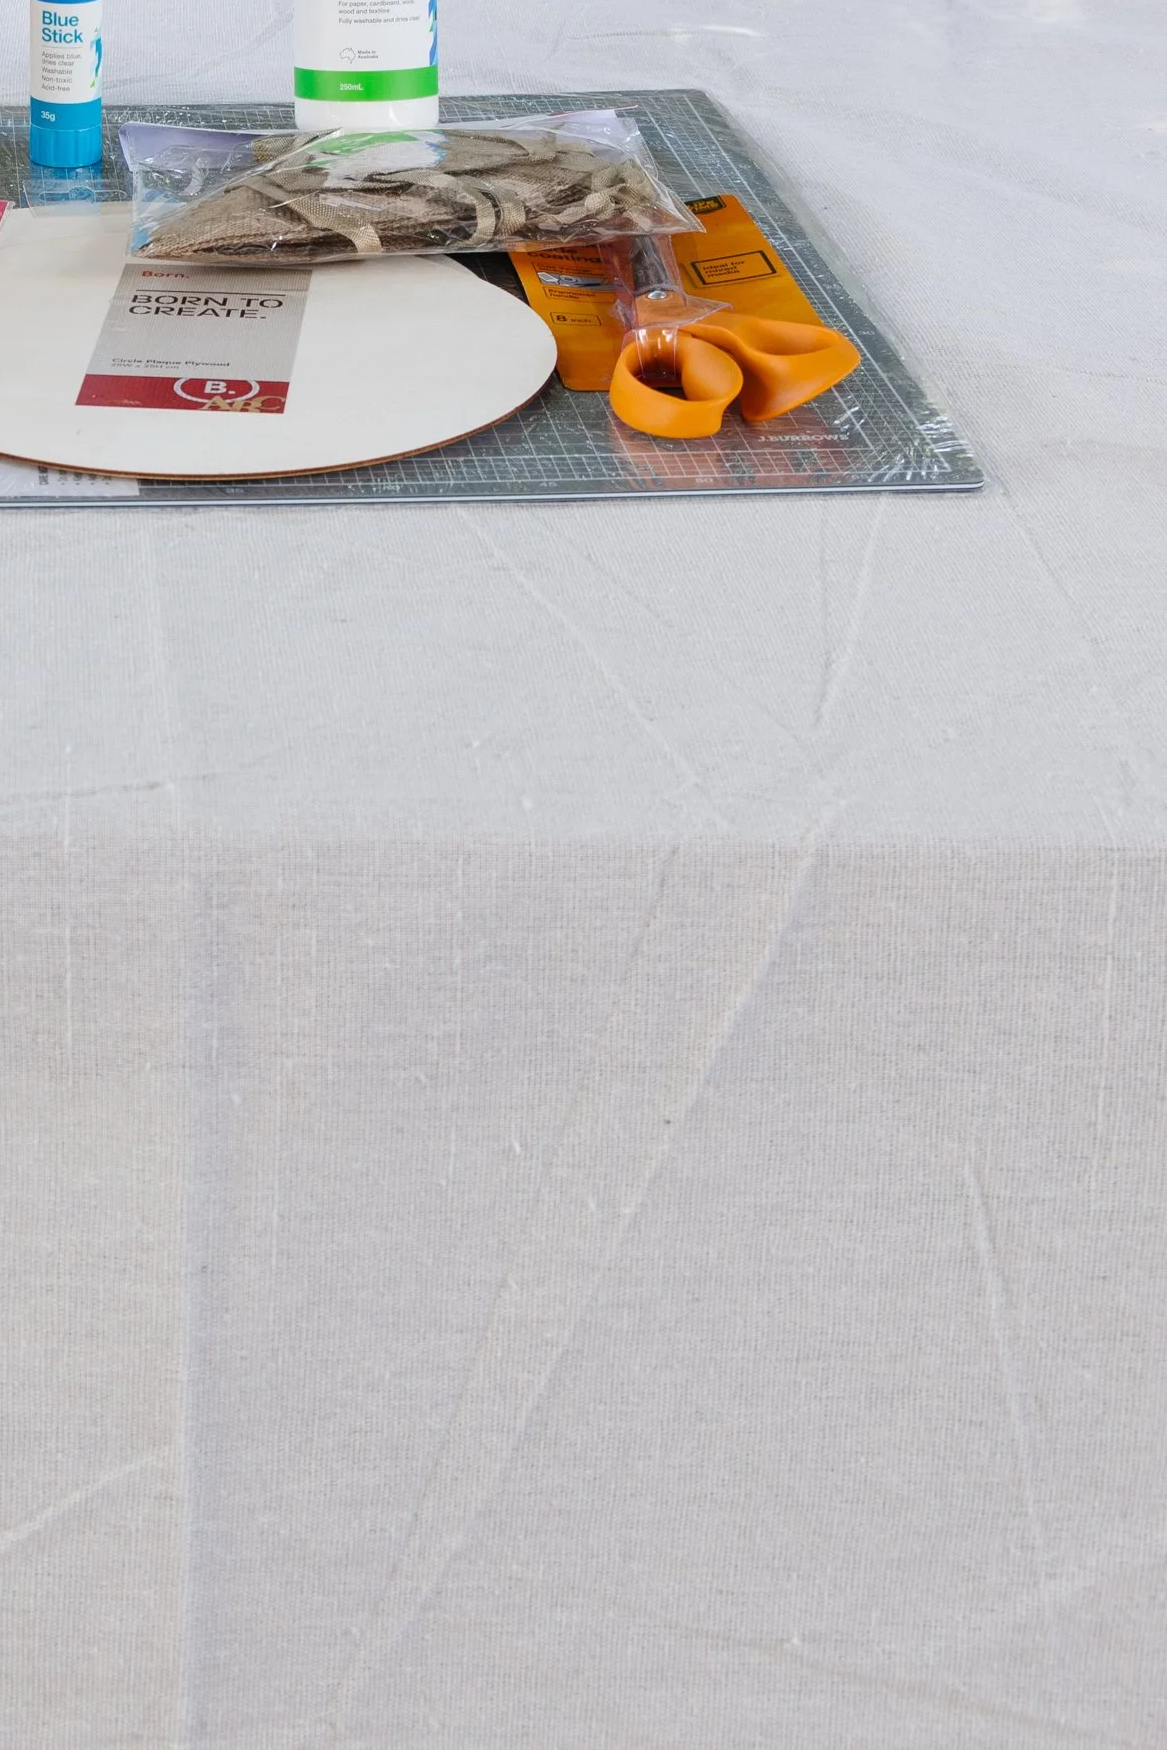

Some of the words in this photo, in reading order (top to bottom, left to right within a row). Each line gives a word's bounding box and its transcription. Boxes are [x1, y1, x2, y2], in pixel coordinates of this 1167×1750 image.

[41, 10, 79, 27] Blue
[41, 27, 83, 44] Stick
[40, 110, 56, 122] 35g
[141, 270, 189, 279] Born.
[131, 294, 228, 307] BORN
[240, 298, 283, 309] TO
[128, 305, 267, 319] CREATE.
[556, 314, 568, 322] 8
[203, 380, 236, 395] B.
